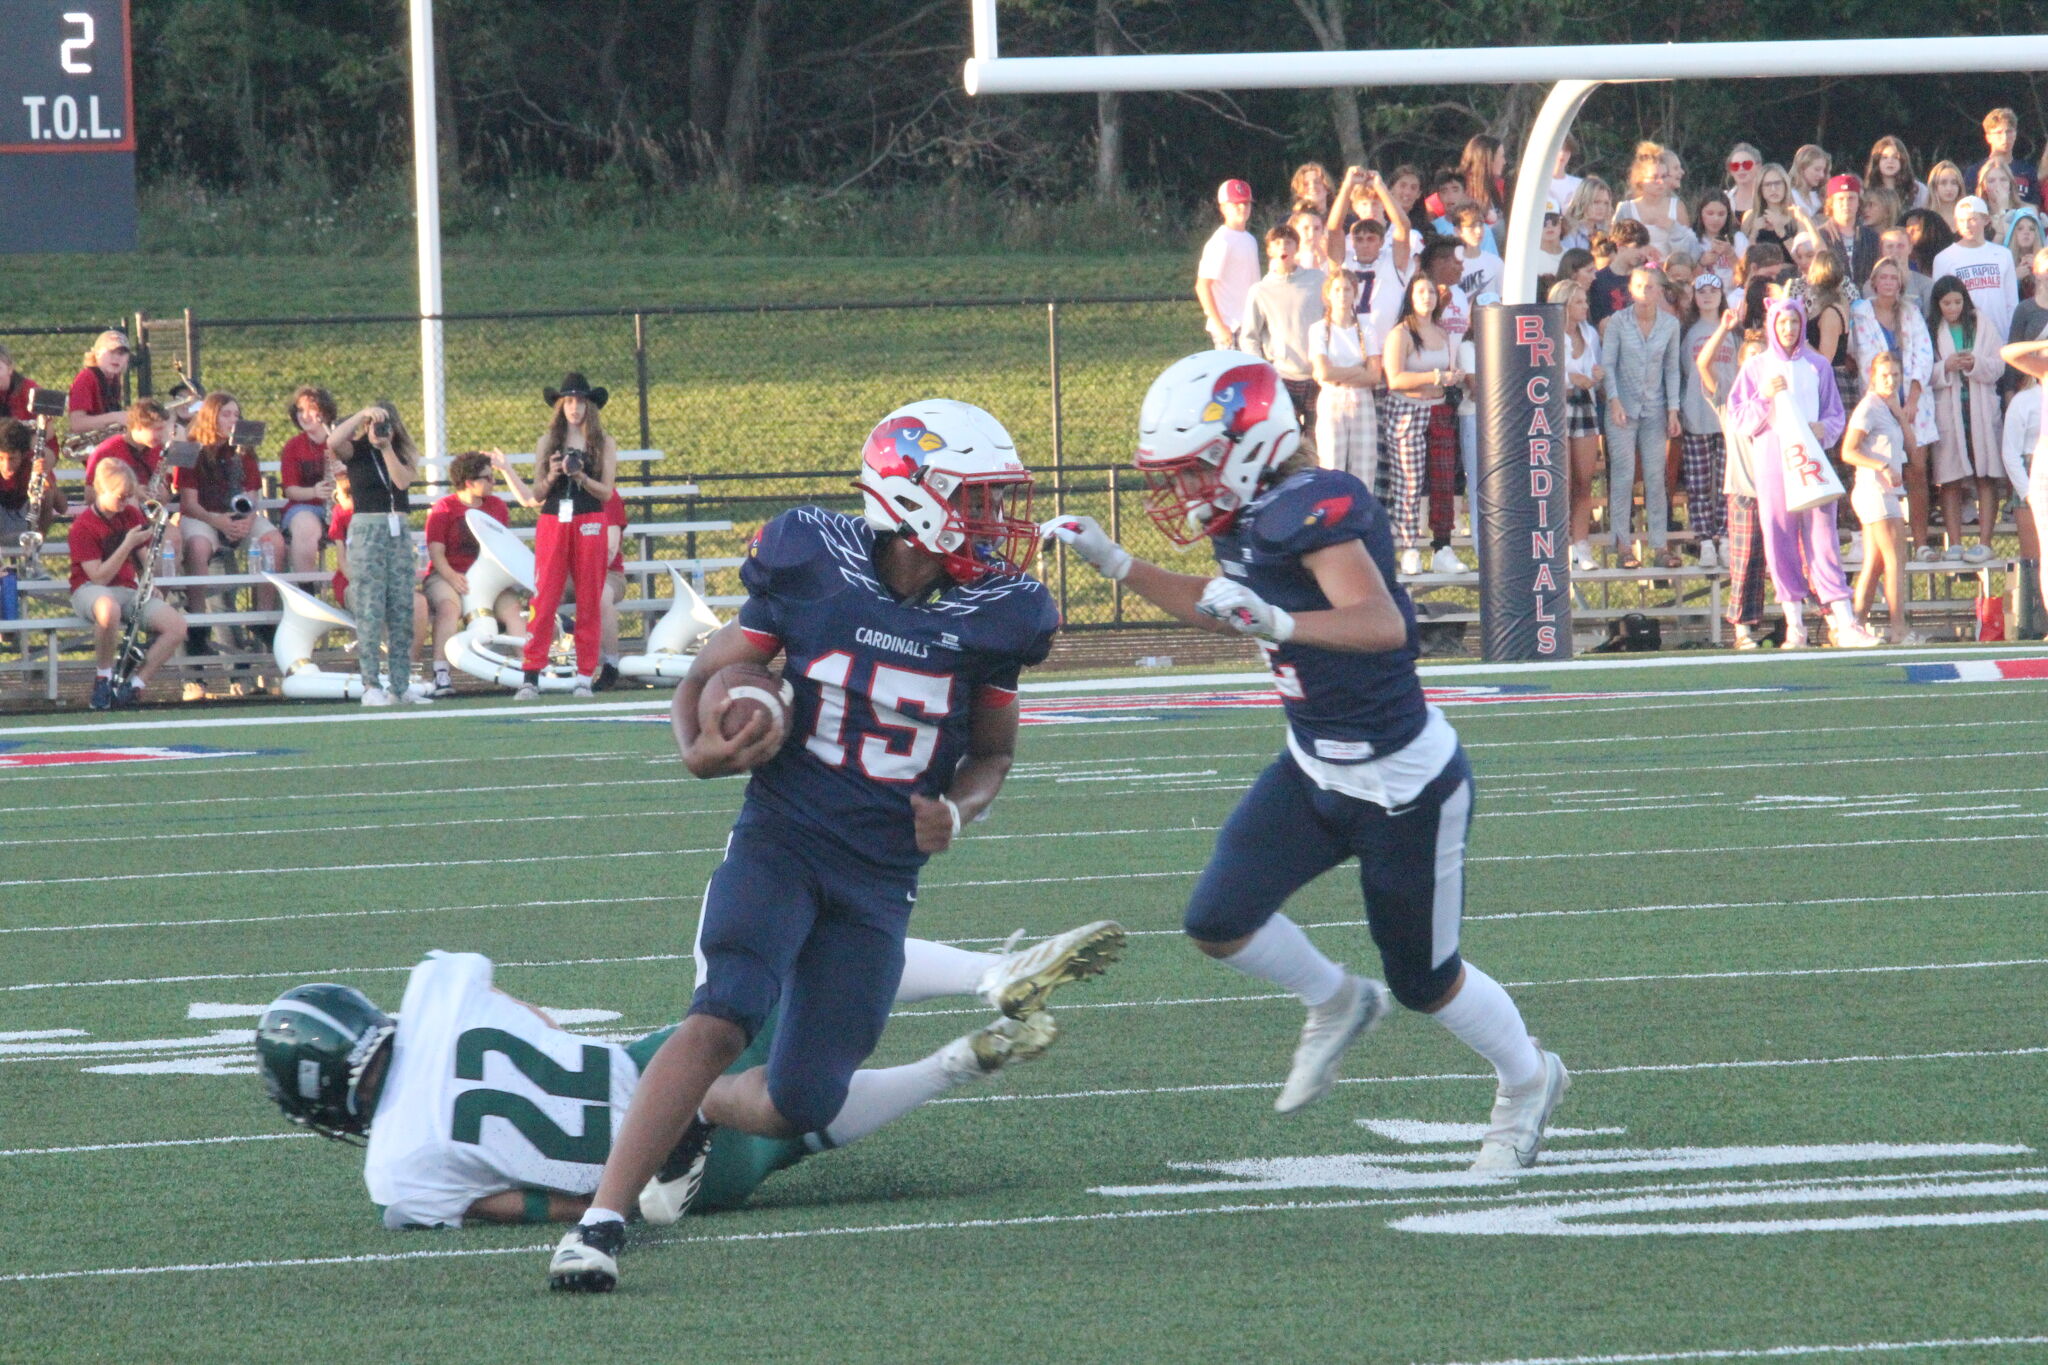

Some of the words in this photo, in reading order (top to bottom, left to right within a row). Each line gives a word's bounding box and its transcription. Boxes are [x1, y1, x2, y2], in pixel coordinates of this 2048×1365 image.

[61, 12, 94, 73] 2
[22, 95, 121, 139] T.O.L.
[1956, 269, 1970, 280] BIG
[1972, 265, 2000, 276] RAPIDS
[1964, 276, 2000, 287] ARDINALS
[1527, 376, 1557, 654] CARDINALS
[855, 627, 931, 659] CARDINALS
[803, 649, 955, 783] 15
[452, 1027, 610, 1165] 22
